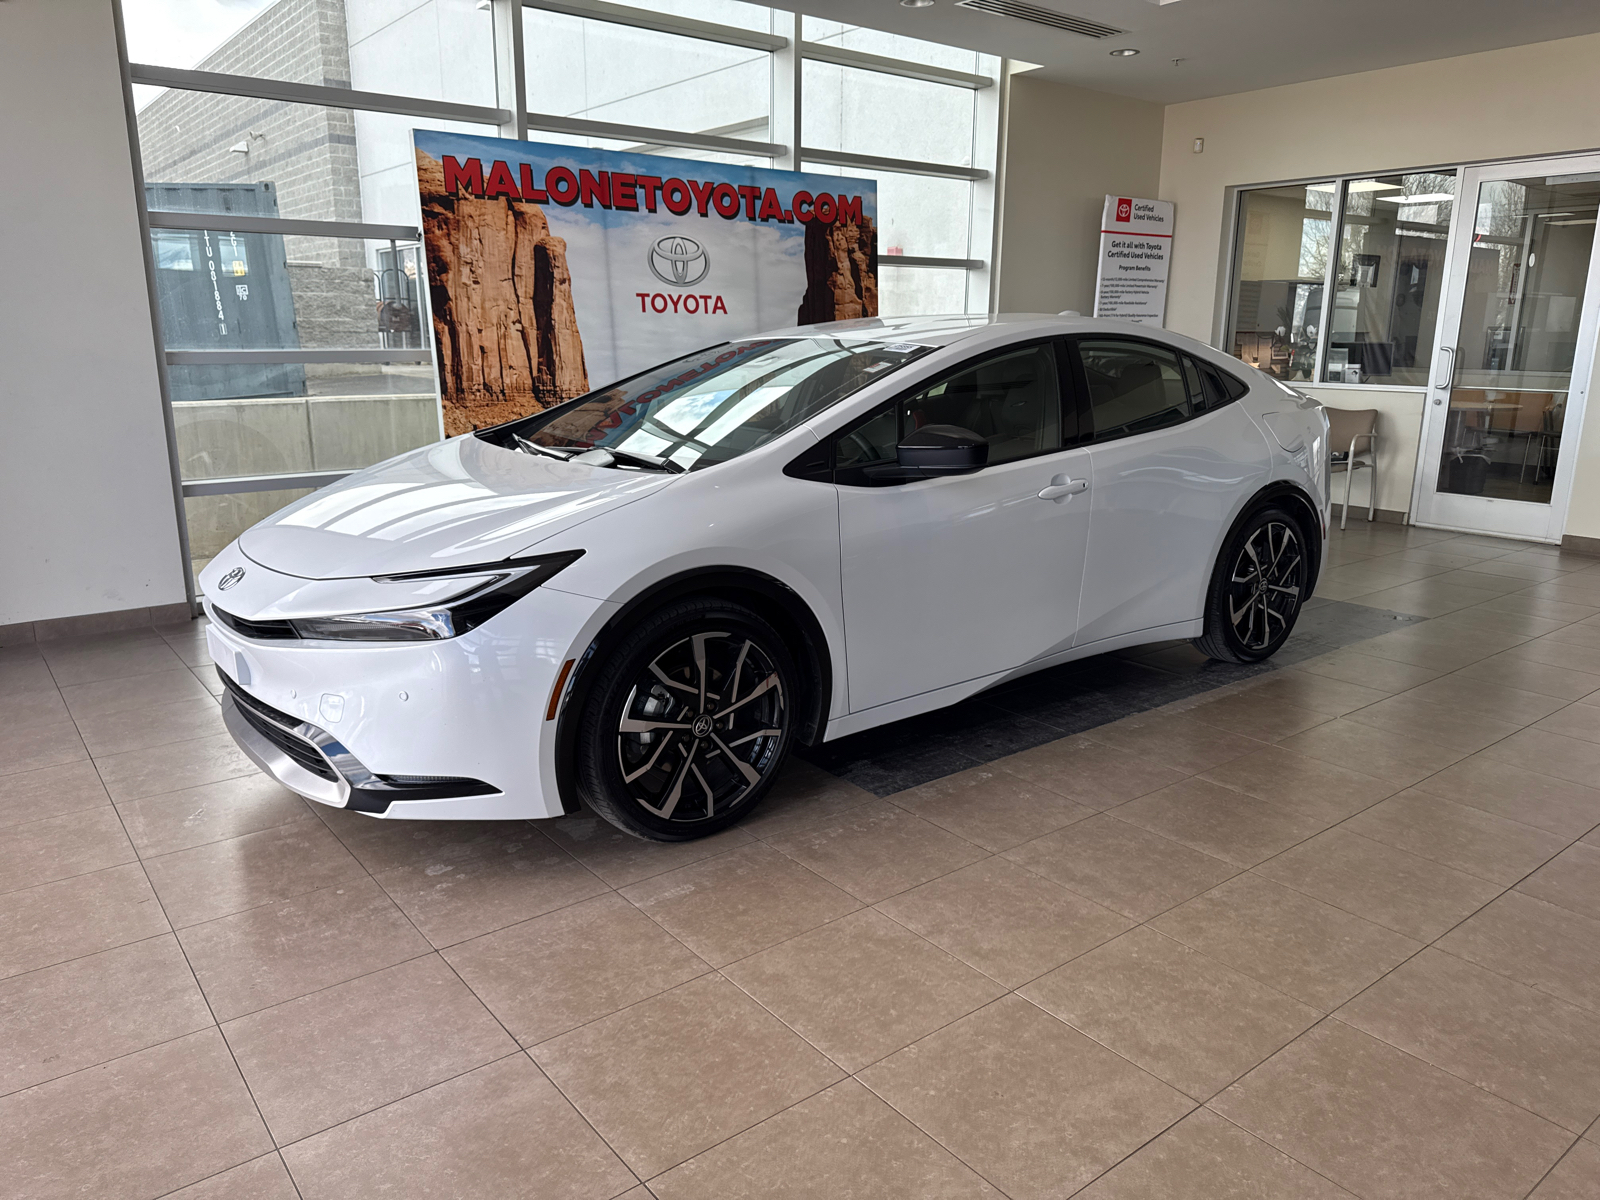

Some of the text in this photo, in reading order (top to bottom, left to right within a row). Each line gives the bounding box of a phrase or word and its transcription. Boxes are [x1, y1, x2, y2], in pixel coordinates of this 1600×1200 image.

[442, 154, 863, 226] MALONETOYOTA.COM
[1134, 203, 1154, 212] Certified
[1145, 214, 1164, 222] Vehicles
[1111, 240, 1121, 248] Get
[1134, 242, 1145, 250] with
[1146, 242, 1162, 251] Toyota
[1107, 251, 1130, 259] Certified
[1144, 252, 1164, 261] Vehicles
[636, 292, 728, 315] TOYOTA
